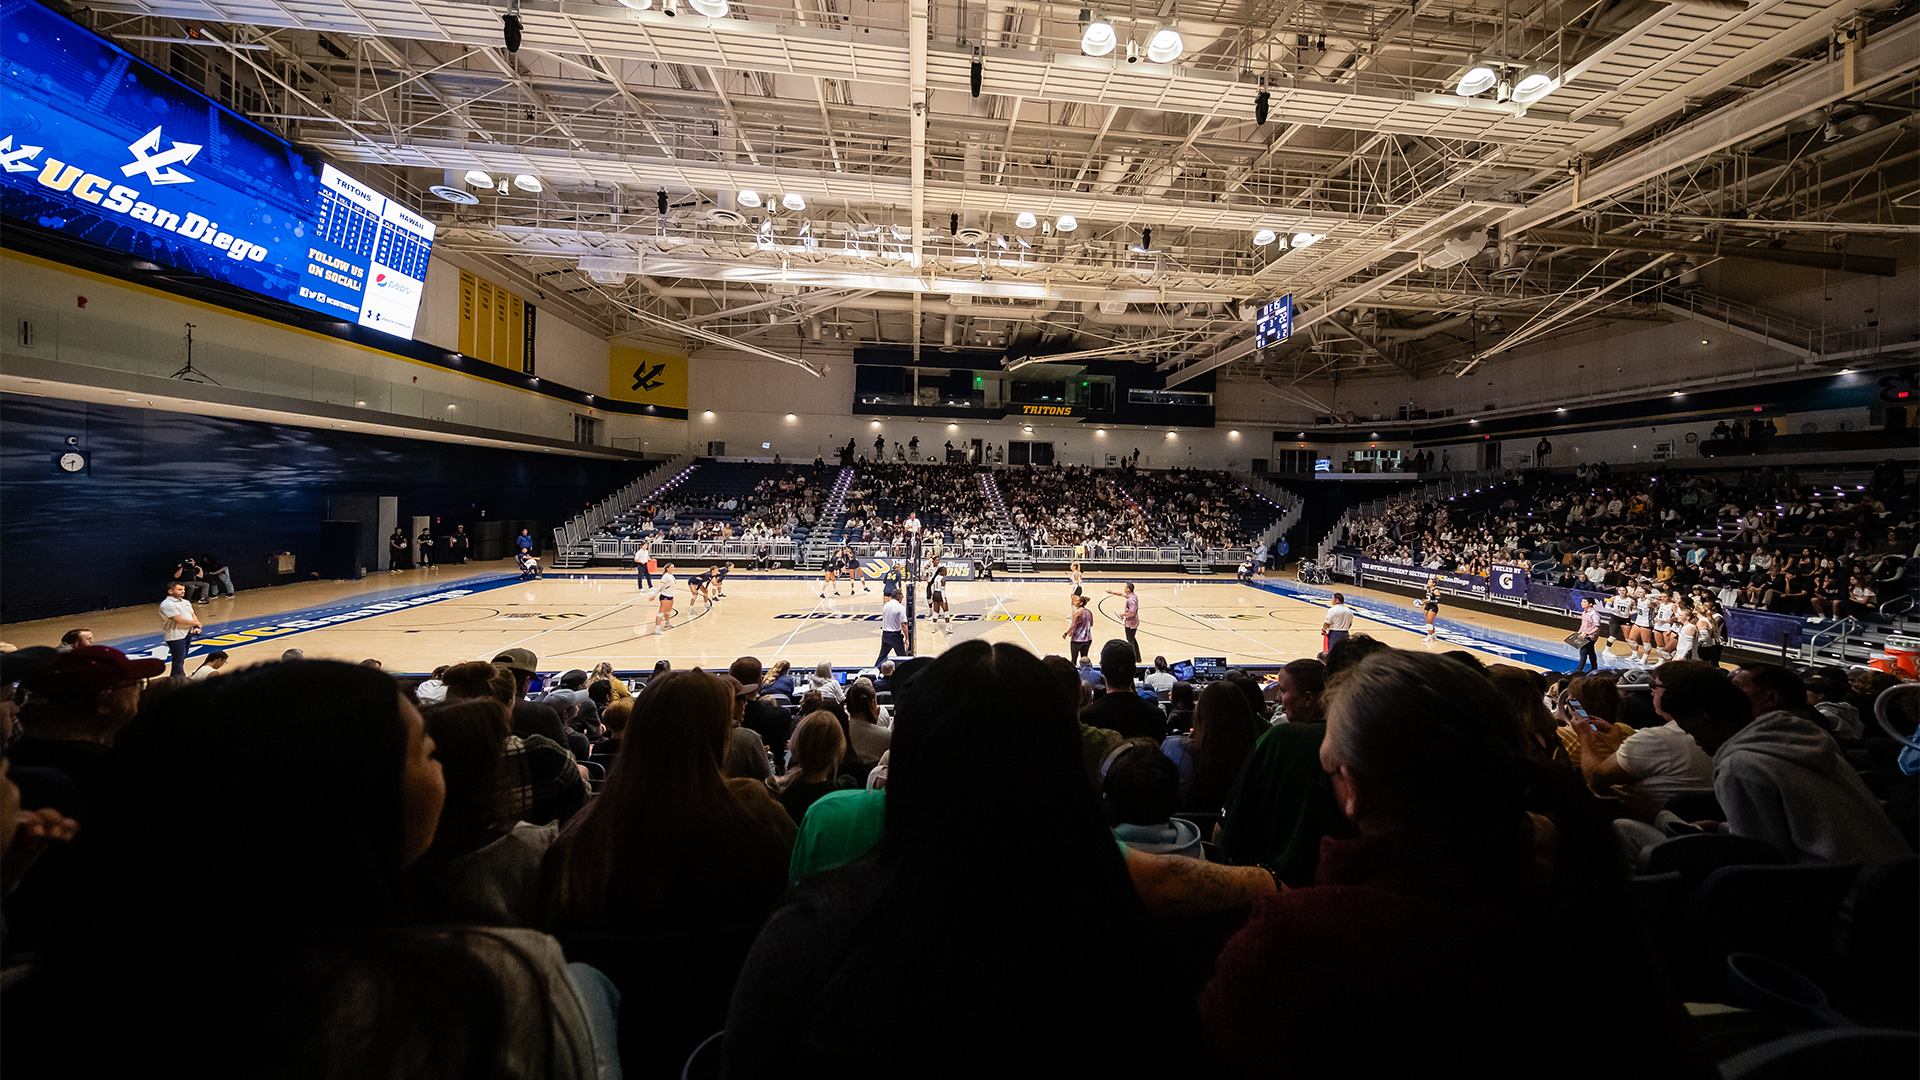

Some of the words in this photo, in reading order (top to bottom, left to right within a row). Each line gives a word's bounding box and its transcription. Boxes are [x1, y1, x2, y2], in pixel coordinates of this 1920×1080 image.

[336, 178, 372, 202] TRITONS
[400, 212, 424, 230] HAWAII
[308, 248, 350, 272] FOLLOW
[351, 264, 364, 278] US
[308, 264, 324, 278] ON
[324, 270, 362, 291] SOCIAL!
[1023, 406, 1072, 416] TRITONS
[1492, 564, 1512, 573] FUELED
[1499, 573, 1513, 590] G
